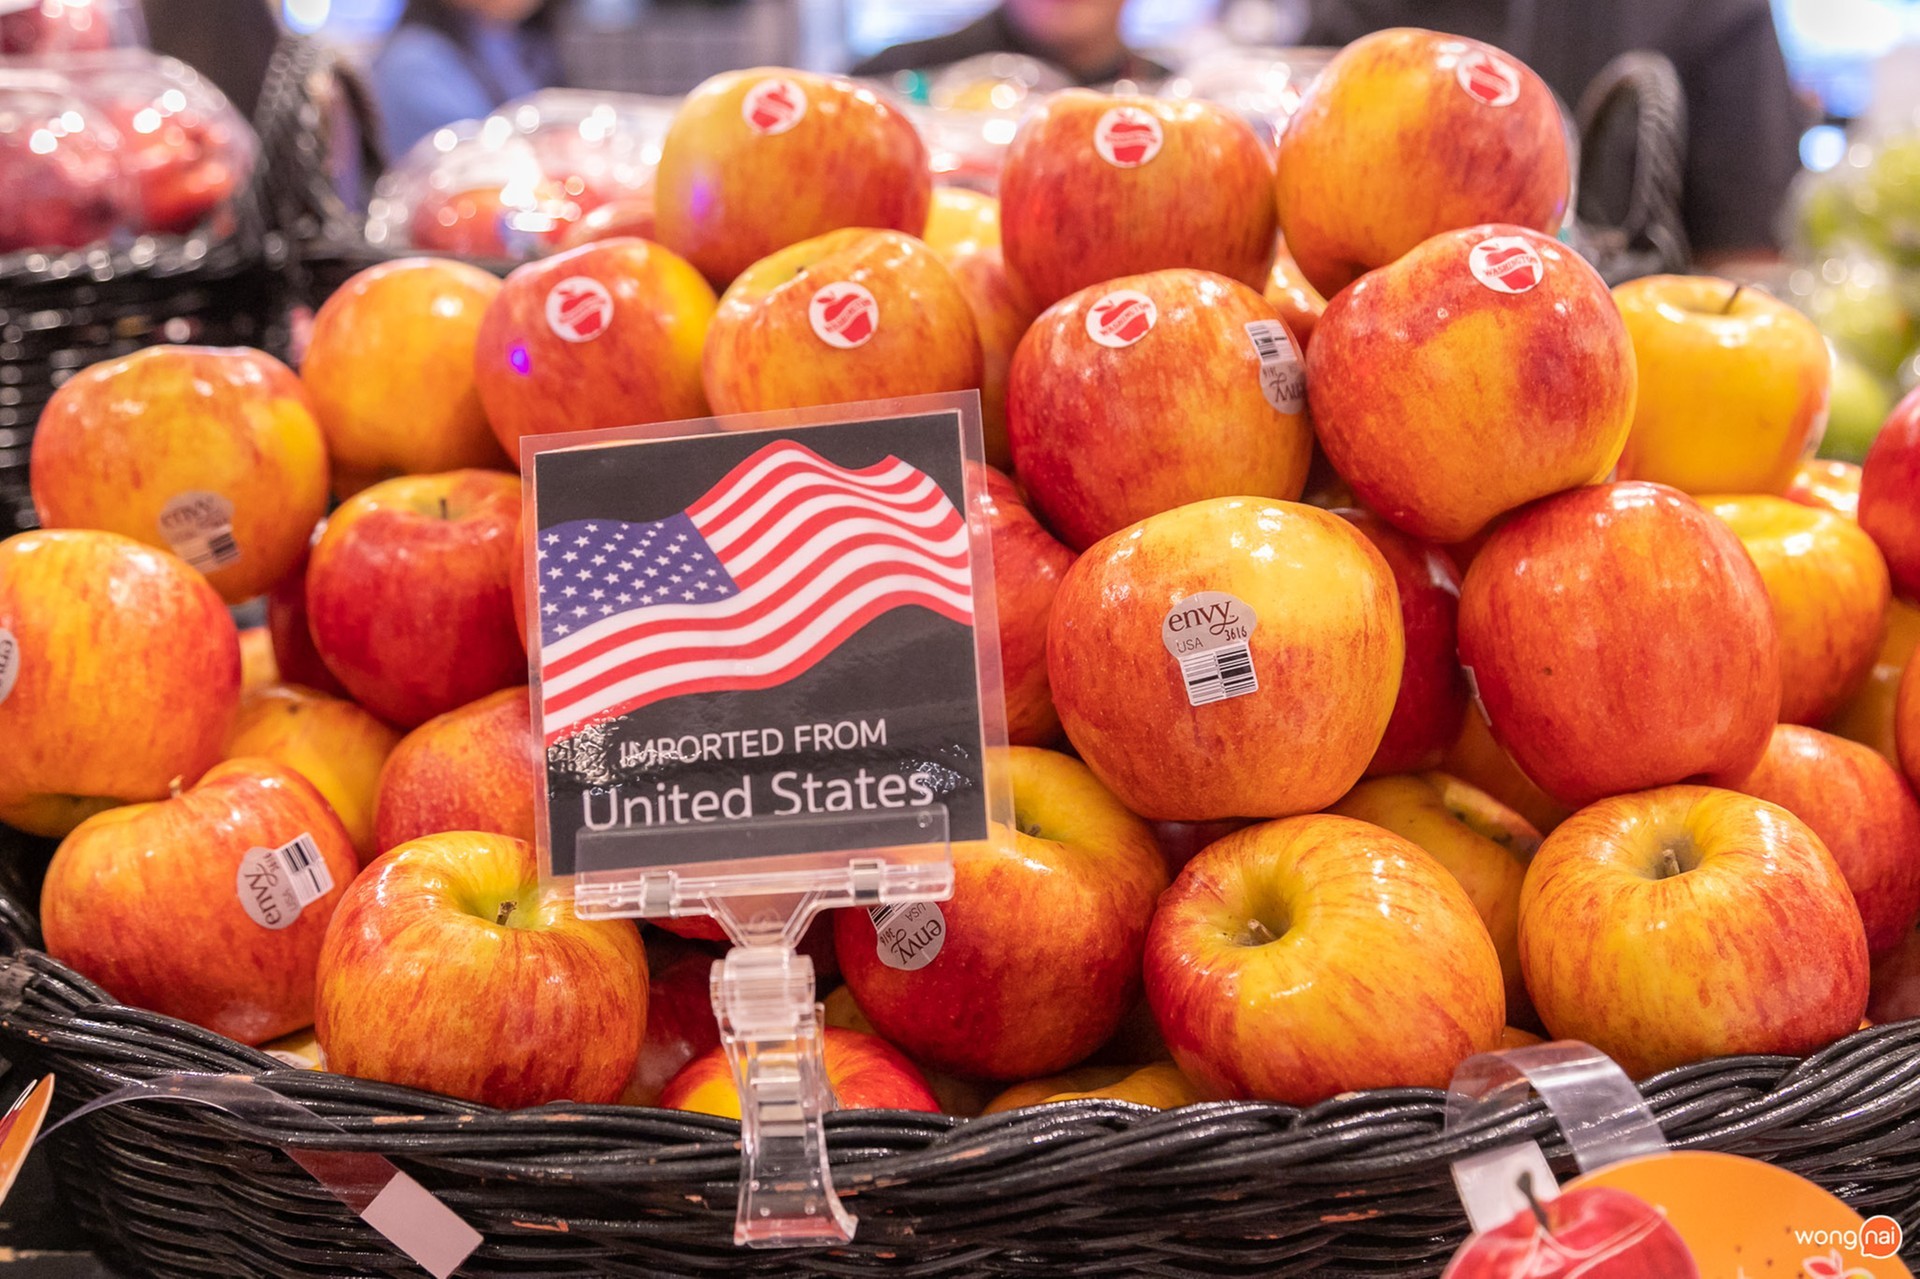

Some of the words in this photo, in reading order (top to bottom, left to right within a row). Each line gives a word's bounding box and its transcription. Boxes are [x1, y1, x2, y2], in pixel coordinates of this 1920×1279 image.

[1168, 600, 1239, 636] envy
[1176, 637, 1204, 653] USA
[1224, 625, 1248, 641] 3616
[620, 727, 784, 768] IMPORTED
[794, 718, 888, 753] FROM
[582, 775, 753, 832] United
[771, 768, 935, 817] States
[243, 862, 282, 925] envy
[904, 902, 927, 922] USA
[879, 927, 896, 947] 3616
[890, 919, 942, 965] envy
